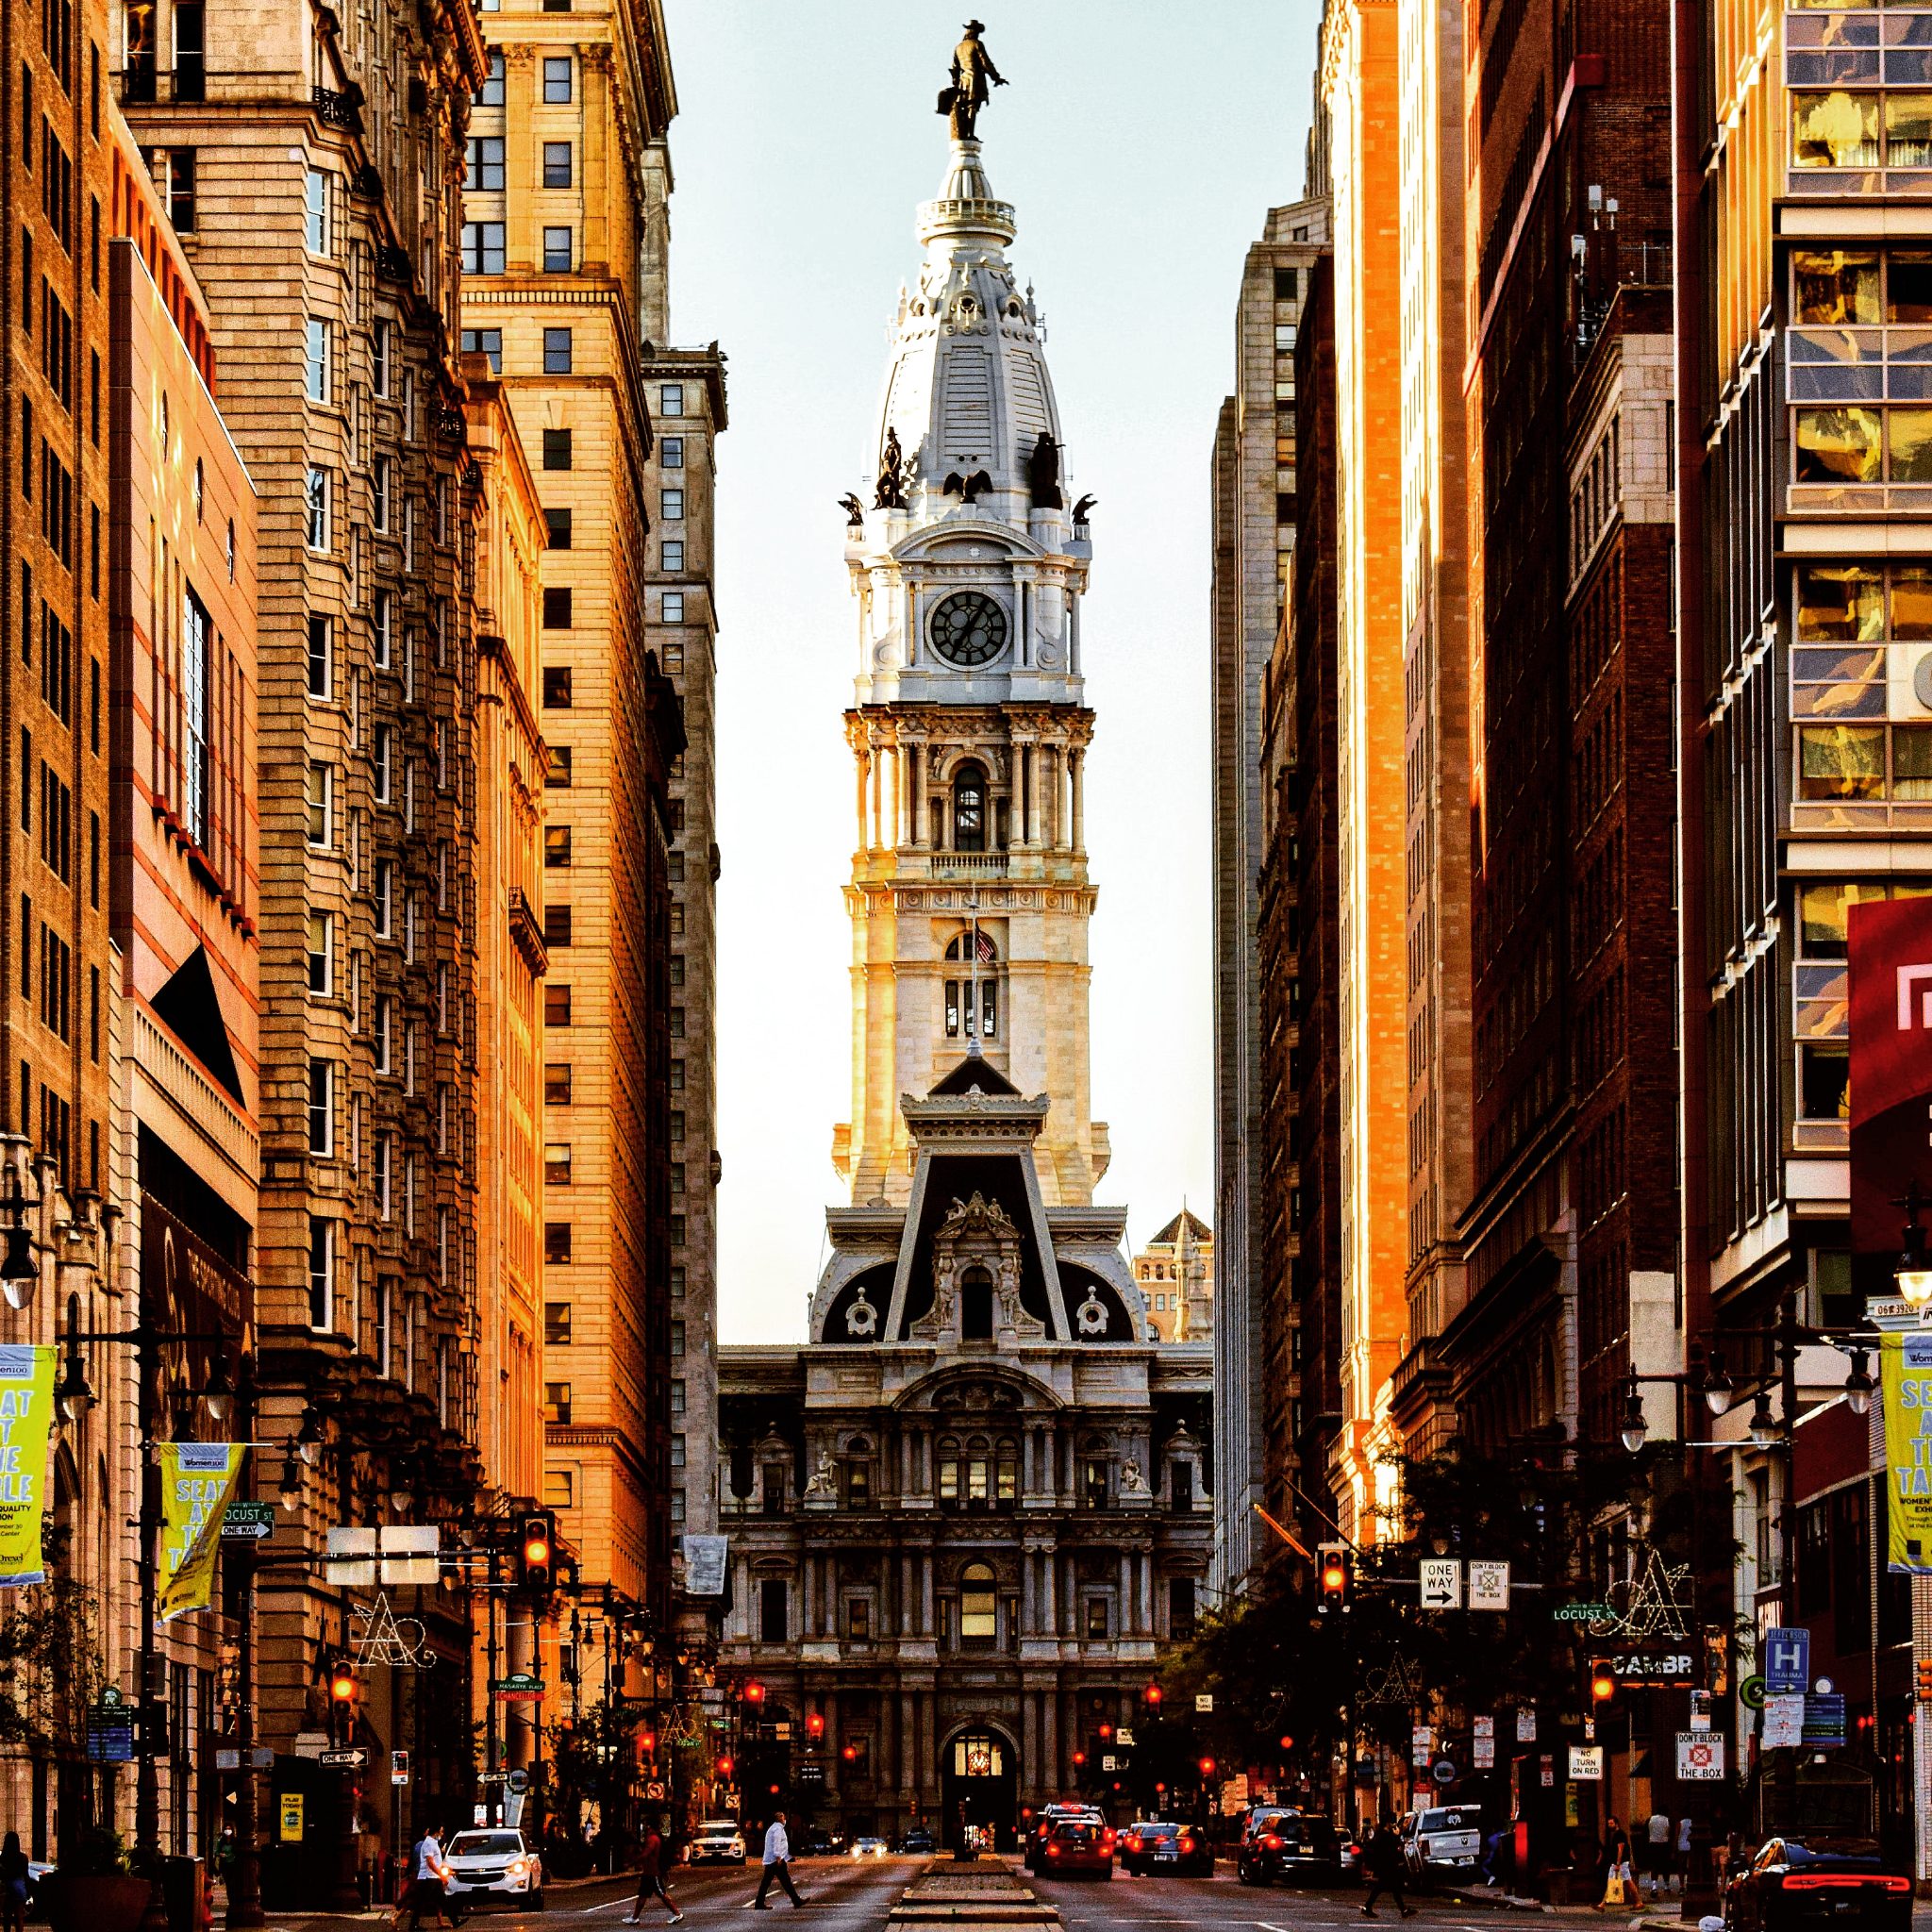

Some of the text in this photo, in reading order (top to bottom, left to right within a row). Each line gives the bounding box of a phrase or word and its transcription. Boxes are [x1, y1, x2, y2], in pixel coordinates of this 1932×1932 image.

[0, 1474, 34, 1502] LE
[176, 1479, 228, 1502] SEAT
[224, 1508, 273, 1520] OCUST ST
[1428, 1564, 1453, 1575] ONE
[1427, 1577, 1454, 1588] WAY
[1554, 1609, 1602, 1621] LOCUST
[1774, 1643, 1800, 1670] H
[1699, 1734, 1723, 1743] BLOCK
[1680, 1768, 1722, 1778] THE BOX
